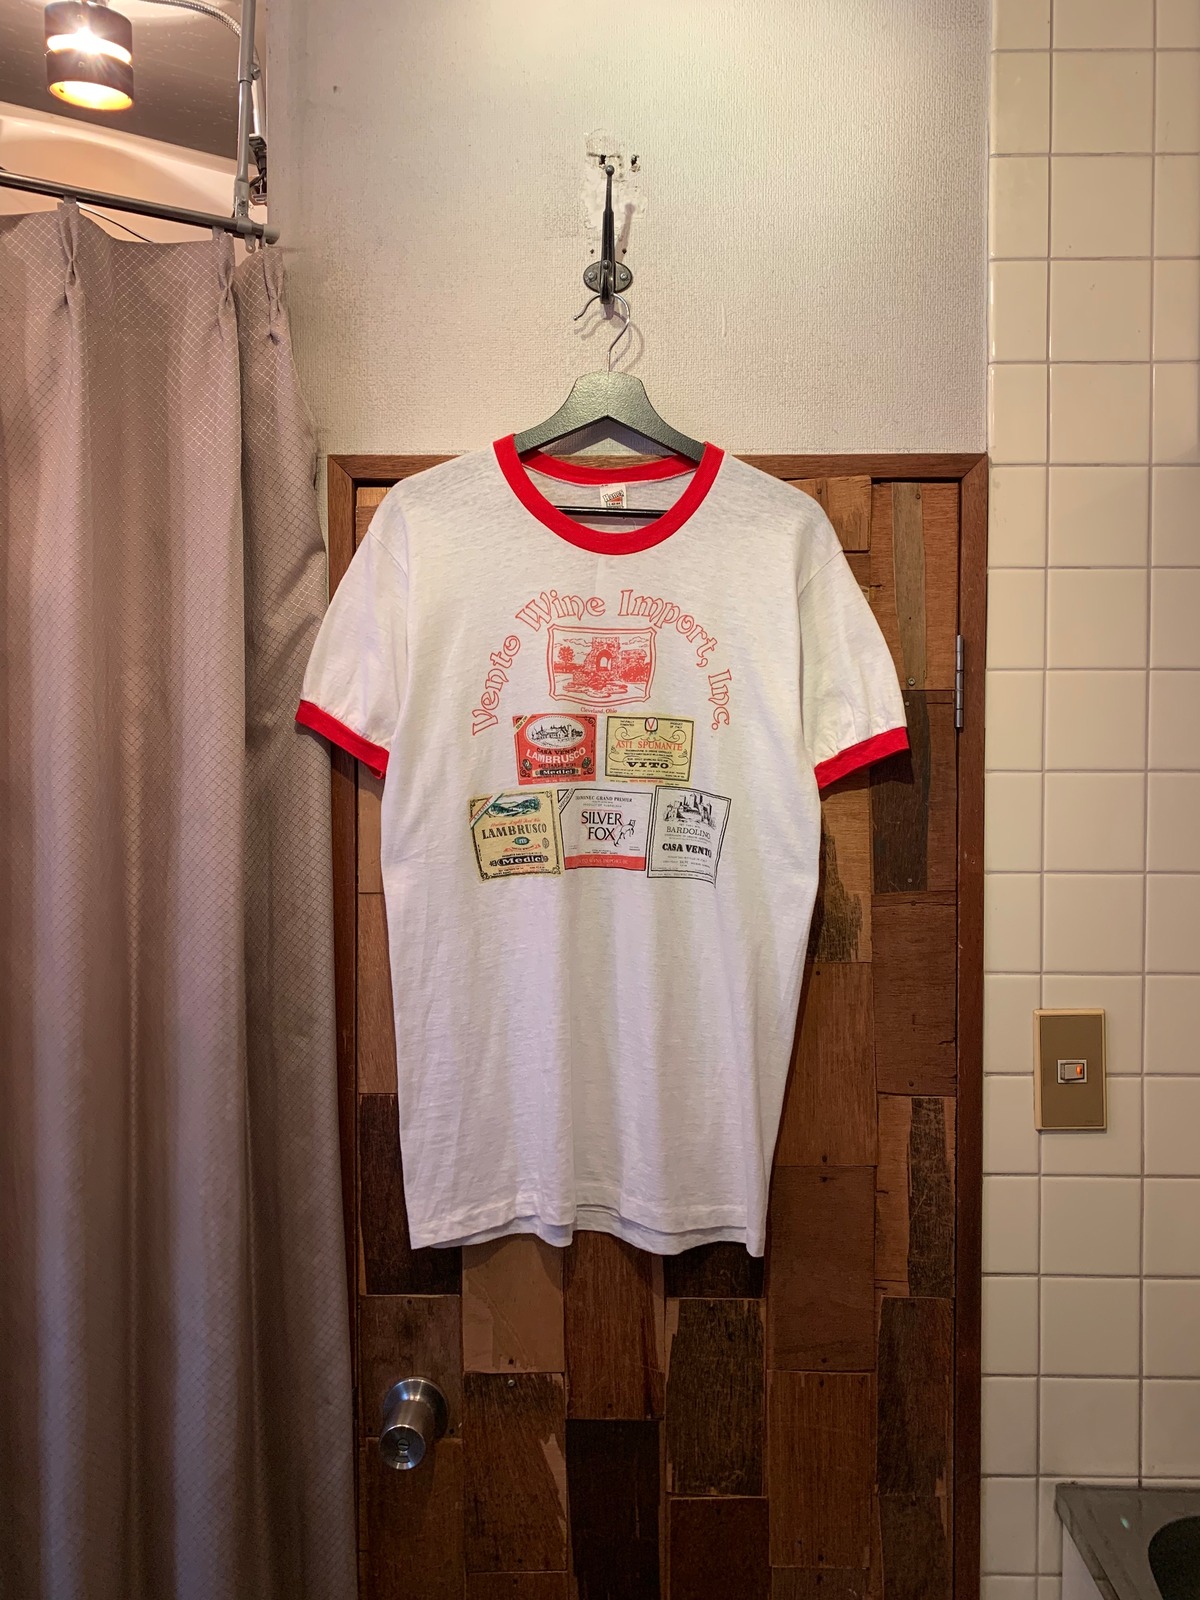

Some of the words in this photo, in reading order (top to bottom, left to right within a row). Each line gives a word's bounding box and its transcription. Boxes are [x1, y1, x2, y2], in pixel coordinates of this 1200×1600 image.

[472, 635, 521, 736] Vento
[515, 589, 606, 632] Wine
[617, 589, 718, 668] Import,
[708, 668, 732, 730] Inc.
[616, 740, 633, 749] ASTI
[638, 740, 683, 751] SPUMANTE
[526, 747, 587, 764] LAMBRUSCO
[626, 761, 669, 769] VITO
[581, 810, 623, 826] SILVER
[481, 823, 547, 840] LAMBRUSCO
[588, 826, 616, 841] FOX
[666, 825, 711, 840] BARDOLINO
[662, 842, 683, 852] CASA
[686, 844, 713, 858] VENTO
